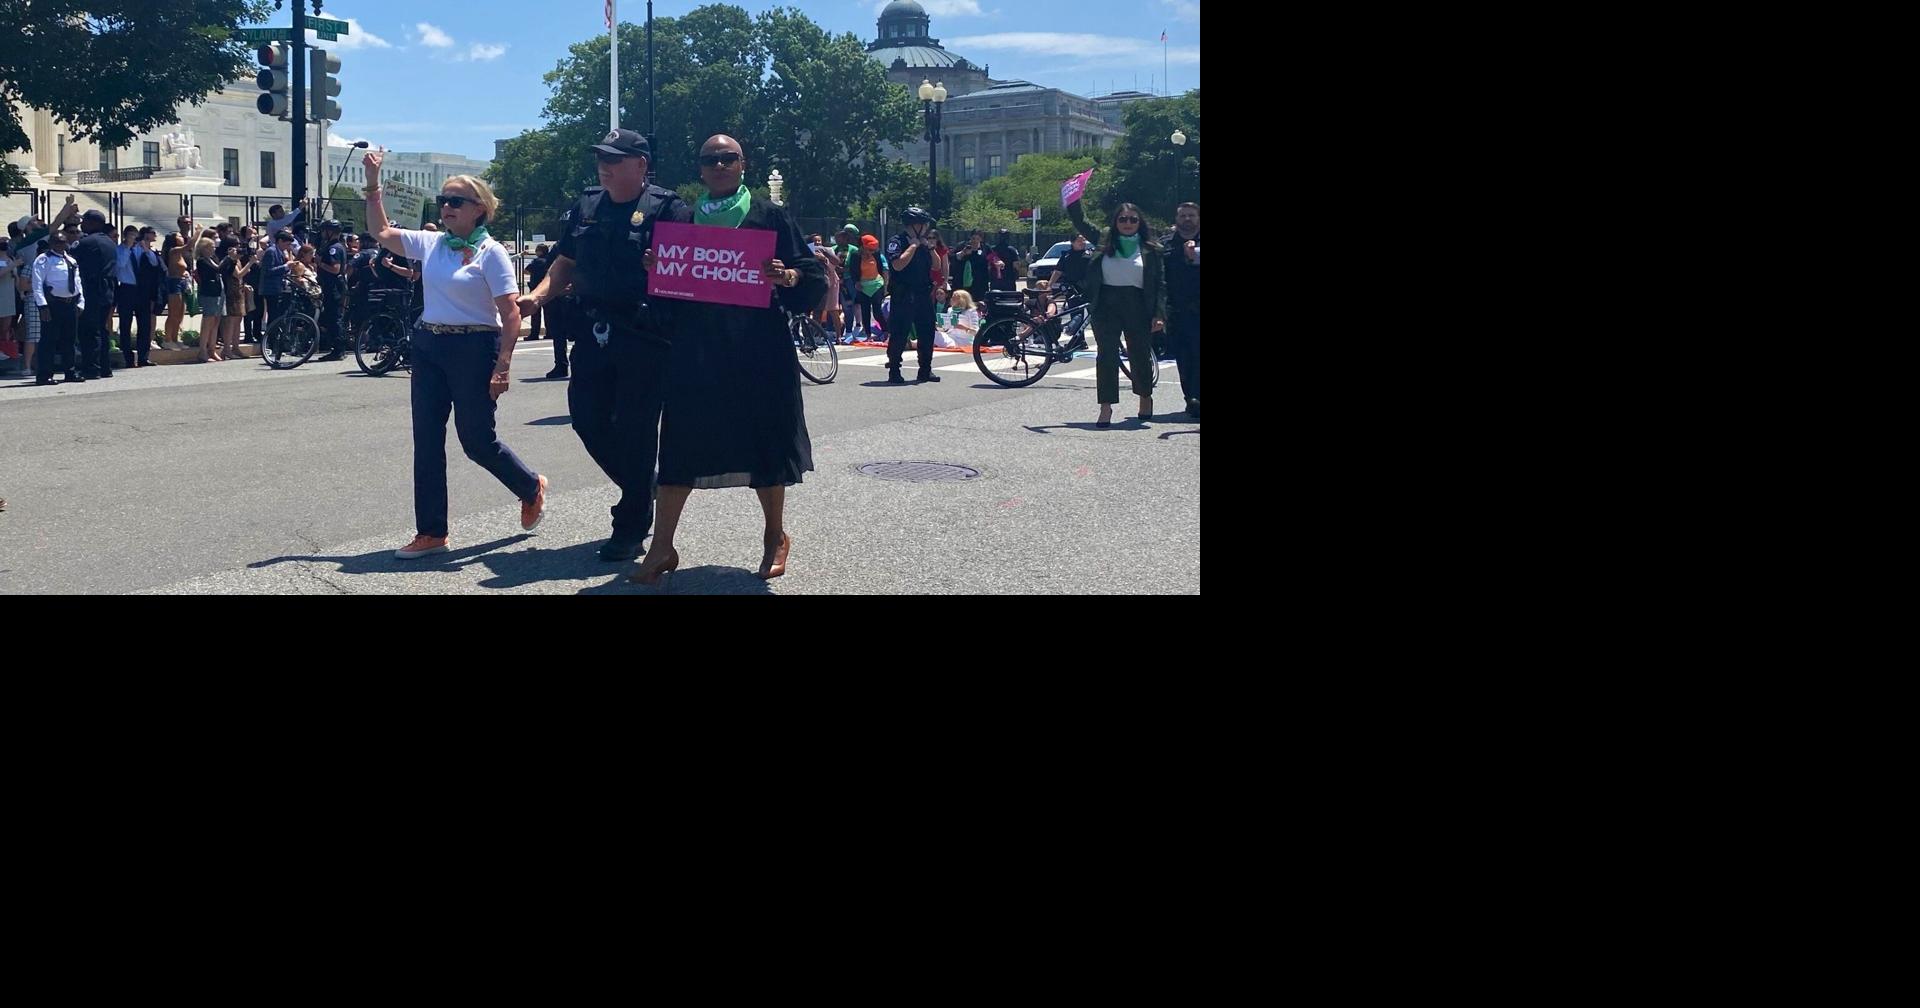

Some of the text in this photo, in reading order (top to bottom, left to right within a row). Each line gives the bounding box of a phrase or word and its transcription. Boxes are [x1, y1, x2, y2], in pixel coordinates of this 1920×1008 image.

[308, 17, 338, 33] FIRST
[241, 29, 278, 40] YLAND
[318, 31, 336, 40] UNIT
[657, 244, 745, 268] MY BODY,
[656, 261, 764, 284] MY CHOICE.
